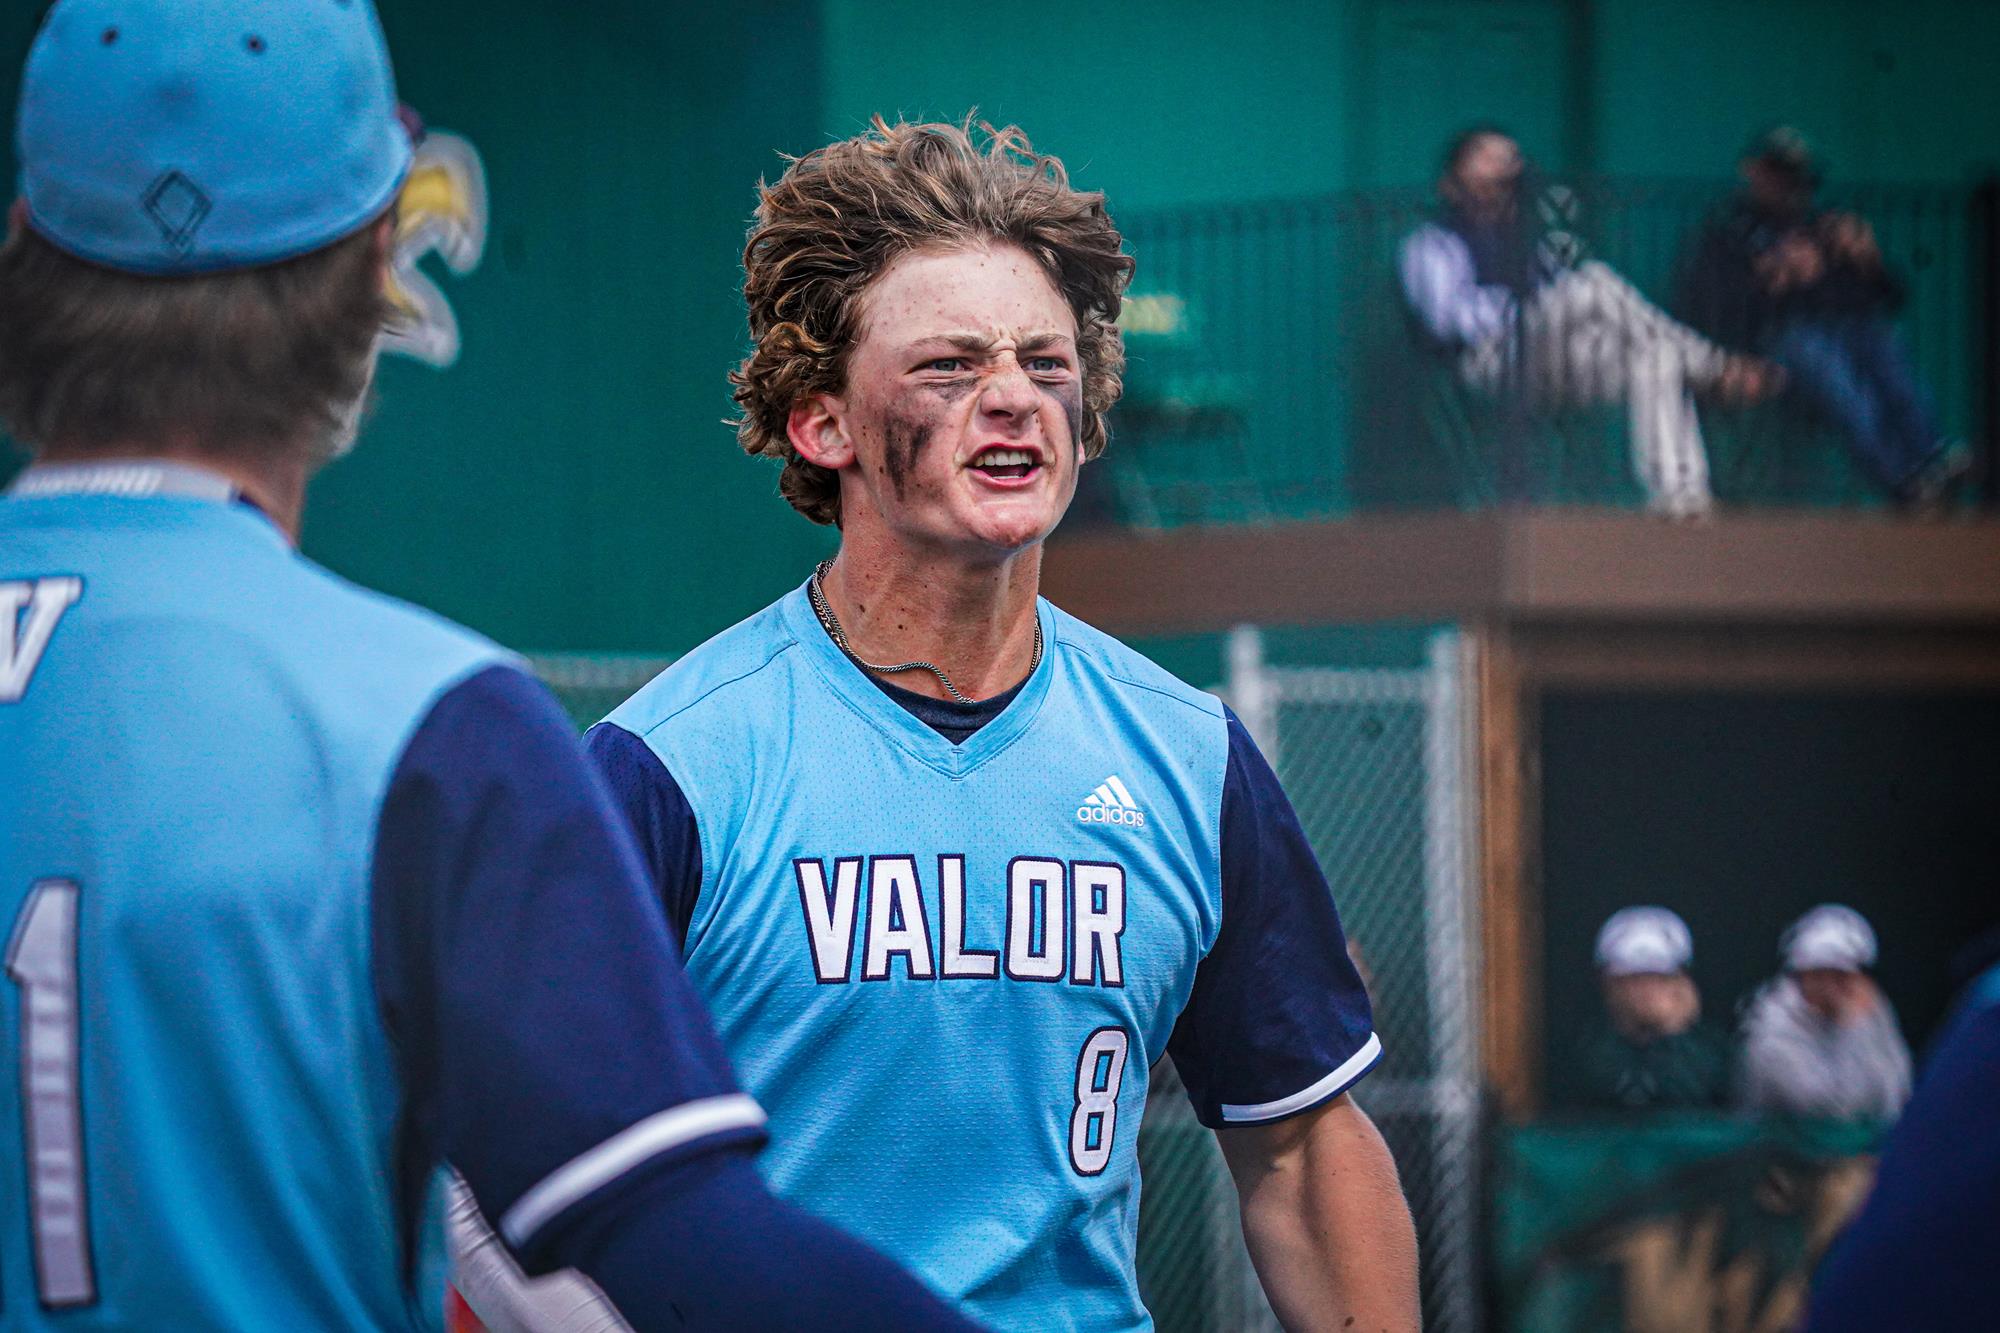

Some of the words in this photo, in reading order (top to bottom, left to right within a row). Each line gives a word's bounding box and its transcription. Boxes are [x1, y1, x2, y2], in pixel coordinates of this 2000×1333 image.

[1076, 802, 1144, 827] adidas
[792, 853, 1126, 988] VALOR
[1068, 1026, 1129, 1177] 8
